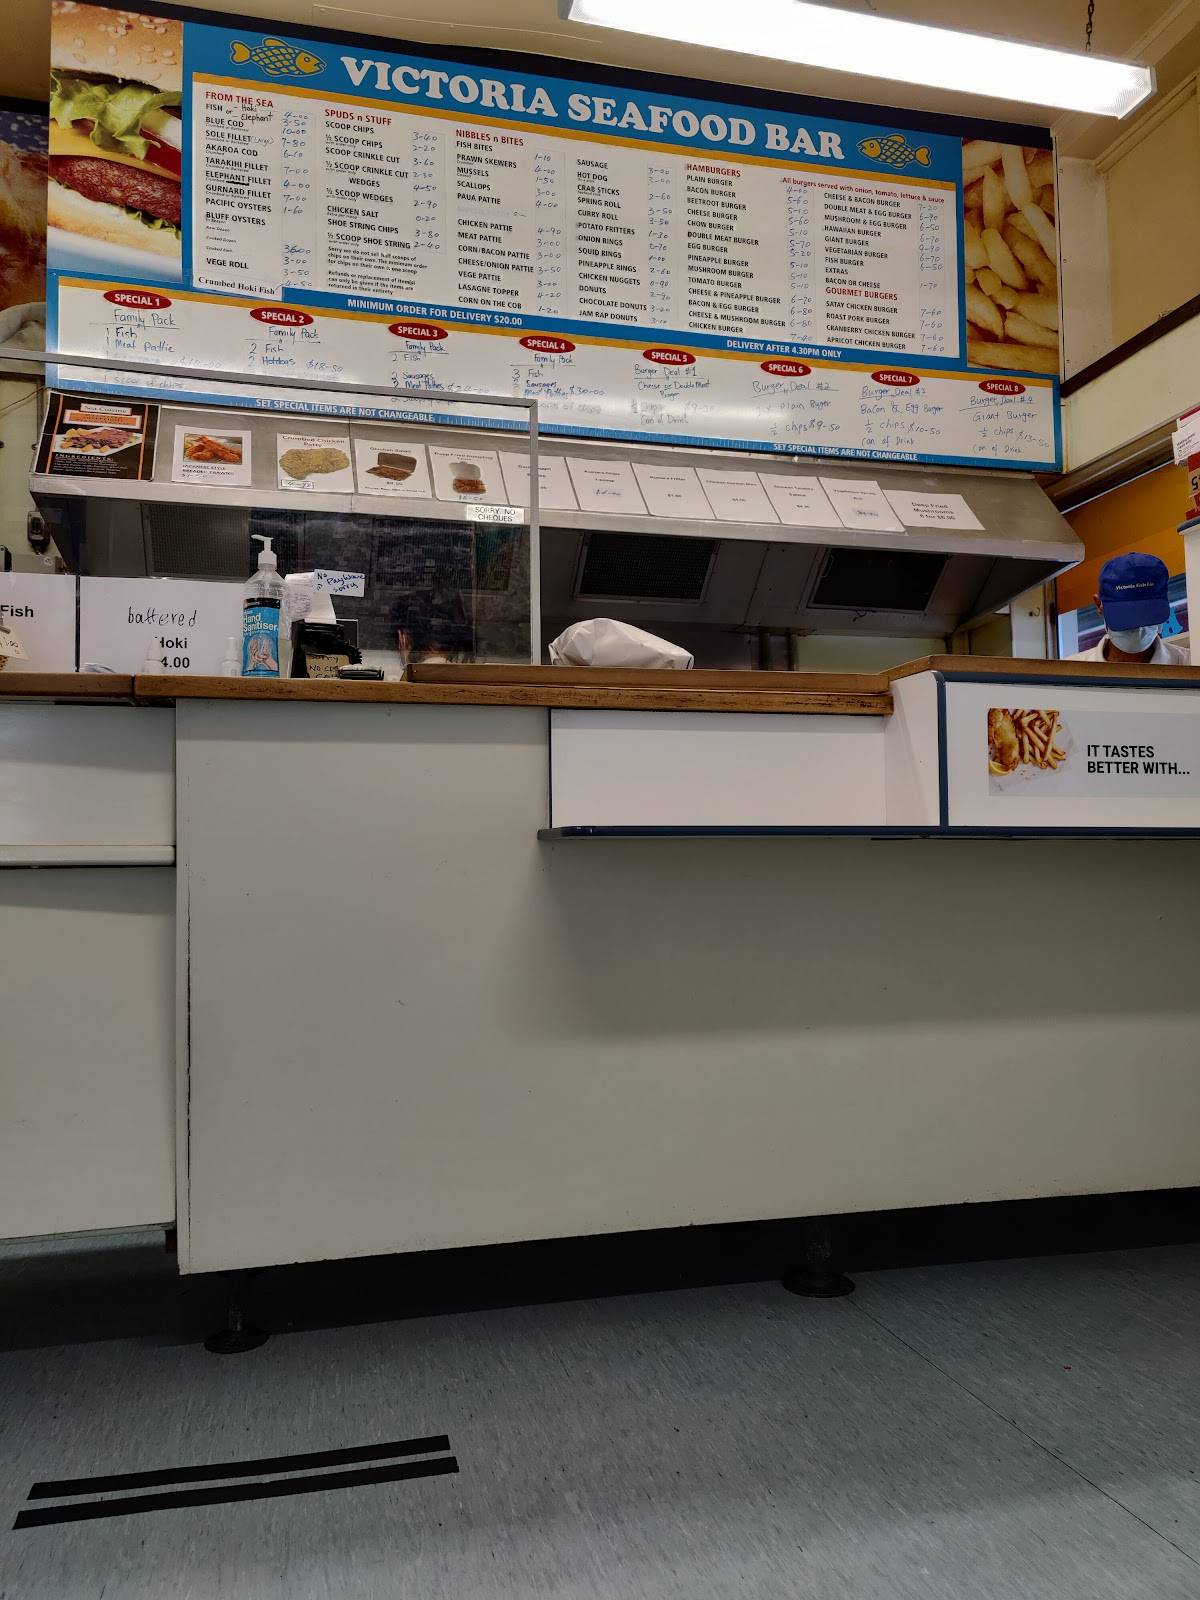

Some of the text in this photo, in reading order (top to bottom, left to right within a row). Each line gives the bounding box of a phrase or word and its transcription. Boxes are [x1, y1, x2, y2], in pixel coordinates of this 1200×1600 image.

[206, 92, 274, 108] FROM THE SEA
[206, 103, 222, 112] FISH
[340, 56, 845, 160] VICTORIA SEAFOOD BAR
[206, 116, 244, 128] BLUE COD
[241, 112, 273, 124] Elephant
[325, 109, 354, 120] SPUDS
[366, 115, 392, 126] STUFF
[326, 121, 374, 134] SCOOP CHIPS
[206, 130, 251, 142] SOLE FILLET
[456, 129, 491, 141] NIBBLES
[501, 136, 524, 146] BITES
[206, 144, 258, 157] AKAROA COD
[456, 141, 493, 152] FISH BITES
[326, 147, 400, 164] SCOOP CRINKLE CUT
[457, 153, 517, 168] PRAWN SKEWERS
[206, 156, 268, 172] TARAKIHI FILLET
[577, 159, 608, 169] SAUSAGE
[206, 170, 272, 185] ELEPHANT FILLET
[457, 166, 489, 177] MUSSELS
[687, 164, 741, 178] HAMBURGERS
[349, 177, 380, 188] WEDGES
[592, 174, 608, 182] DOG
[687, 175, 732, 187] PLAIN BURGER
[457, 181, 491, 191] SCALLOPS
[792, 179, 816, 188] burgers
[817, 182, 838, 190] served
[855, 187, 873, 195] onion,
[875, 190, 898, 198] tomato,
[900, 192, 920, 200] lettuce
[206, 198, 271, 212] PACIFIC OYSTERS
[327, 205, 379, 218] CHICKEN SALT
[206, 212, 229, 220] BLUFF
[232, 215, 266, 226] OYSTERS
[687, 208, 738, 221] CHEESE BURGER
[825, 247, 888, 259] VEGETARIAN BURGER
[206, 258, 248, 269] VEGE ROLL
[688, 265, 754, 278] MUSHROOM BURGER
[198, 276, 275, 295] Crumbed Hoki Fish
[579, 272, 640, 286] CHICKEN NUGGETS
[458, 283, 519, 296] LASAGNE TOPPER
[826, 287, 898, 301] GOURMET BURGERS
[114, 294, 160, 306] SPECIAL 1
[458, 296, 478, 304] CORN
[493, 300, 505, 308] THE
[114, 309, 176, 329] Family Pack
[261, 311, 304, 323] SPECIAL 2
[348, 299, 522, 326] MINIMUM ORDER FOR DELIVERY $20.00
[115, 327, 138, 338] Fish
[269, 326, 319, 343] Family Pack
[398, 326, 430, 336] SPECIAL
[528, 339, 565, 350] SPECIAL 4
[727, 340, 842, 358] DELIVERY AFTER 4.30PM ONLY
[651, 351, 680, 361] SPECIAL
[634, 364, 658, 378] Burger
[664, 367, 680, 376] Deal
[768, 364, 797, 373] SPECIAL
[880, 374, 907, 382] SPECIAL
[753, 381, 784, 394] Burger
[790, 381, 810, 391] Deal
[986, 383, 1013, 391] SPECIAL
[256, 398, 433, 422] SET SPECIAL ITEMS ARE NOT CHANGEABLE
[1007, 411, 1037, 422] Burger
[880, 419, 905, 432] chips
[475, 506, 500, 514] SORRY
[478, 514, 512, 522] CHEQUES
[0, 604, 34, 618] Fish
[128, 606, 196, 627] battered
[244, 612, 261, 623] Hand
[244, 621, 277, 632] Sanitiser
[1088, 745, 1154, 758] IT TASTES
[1088, 762, 1190, 774] BETTER WITH...
